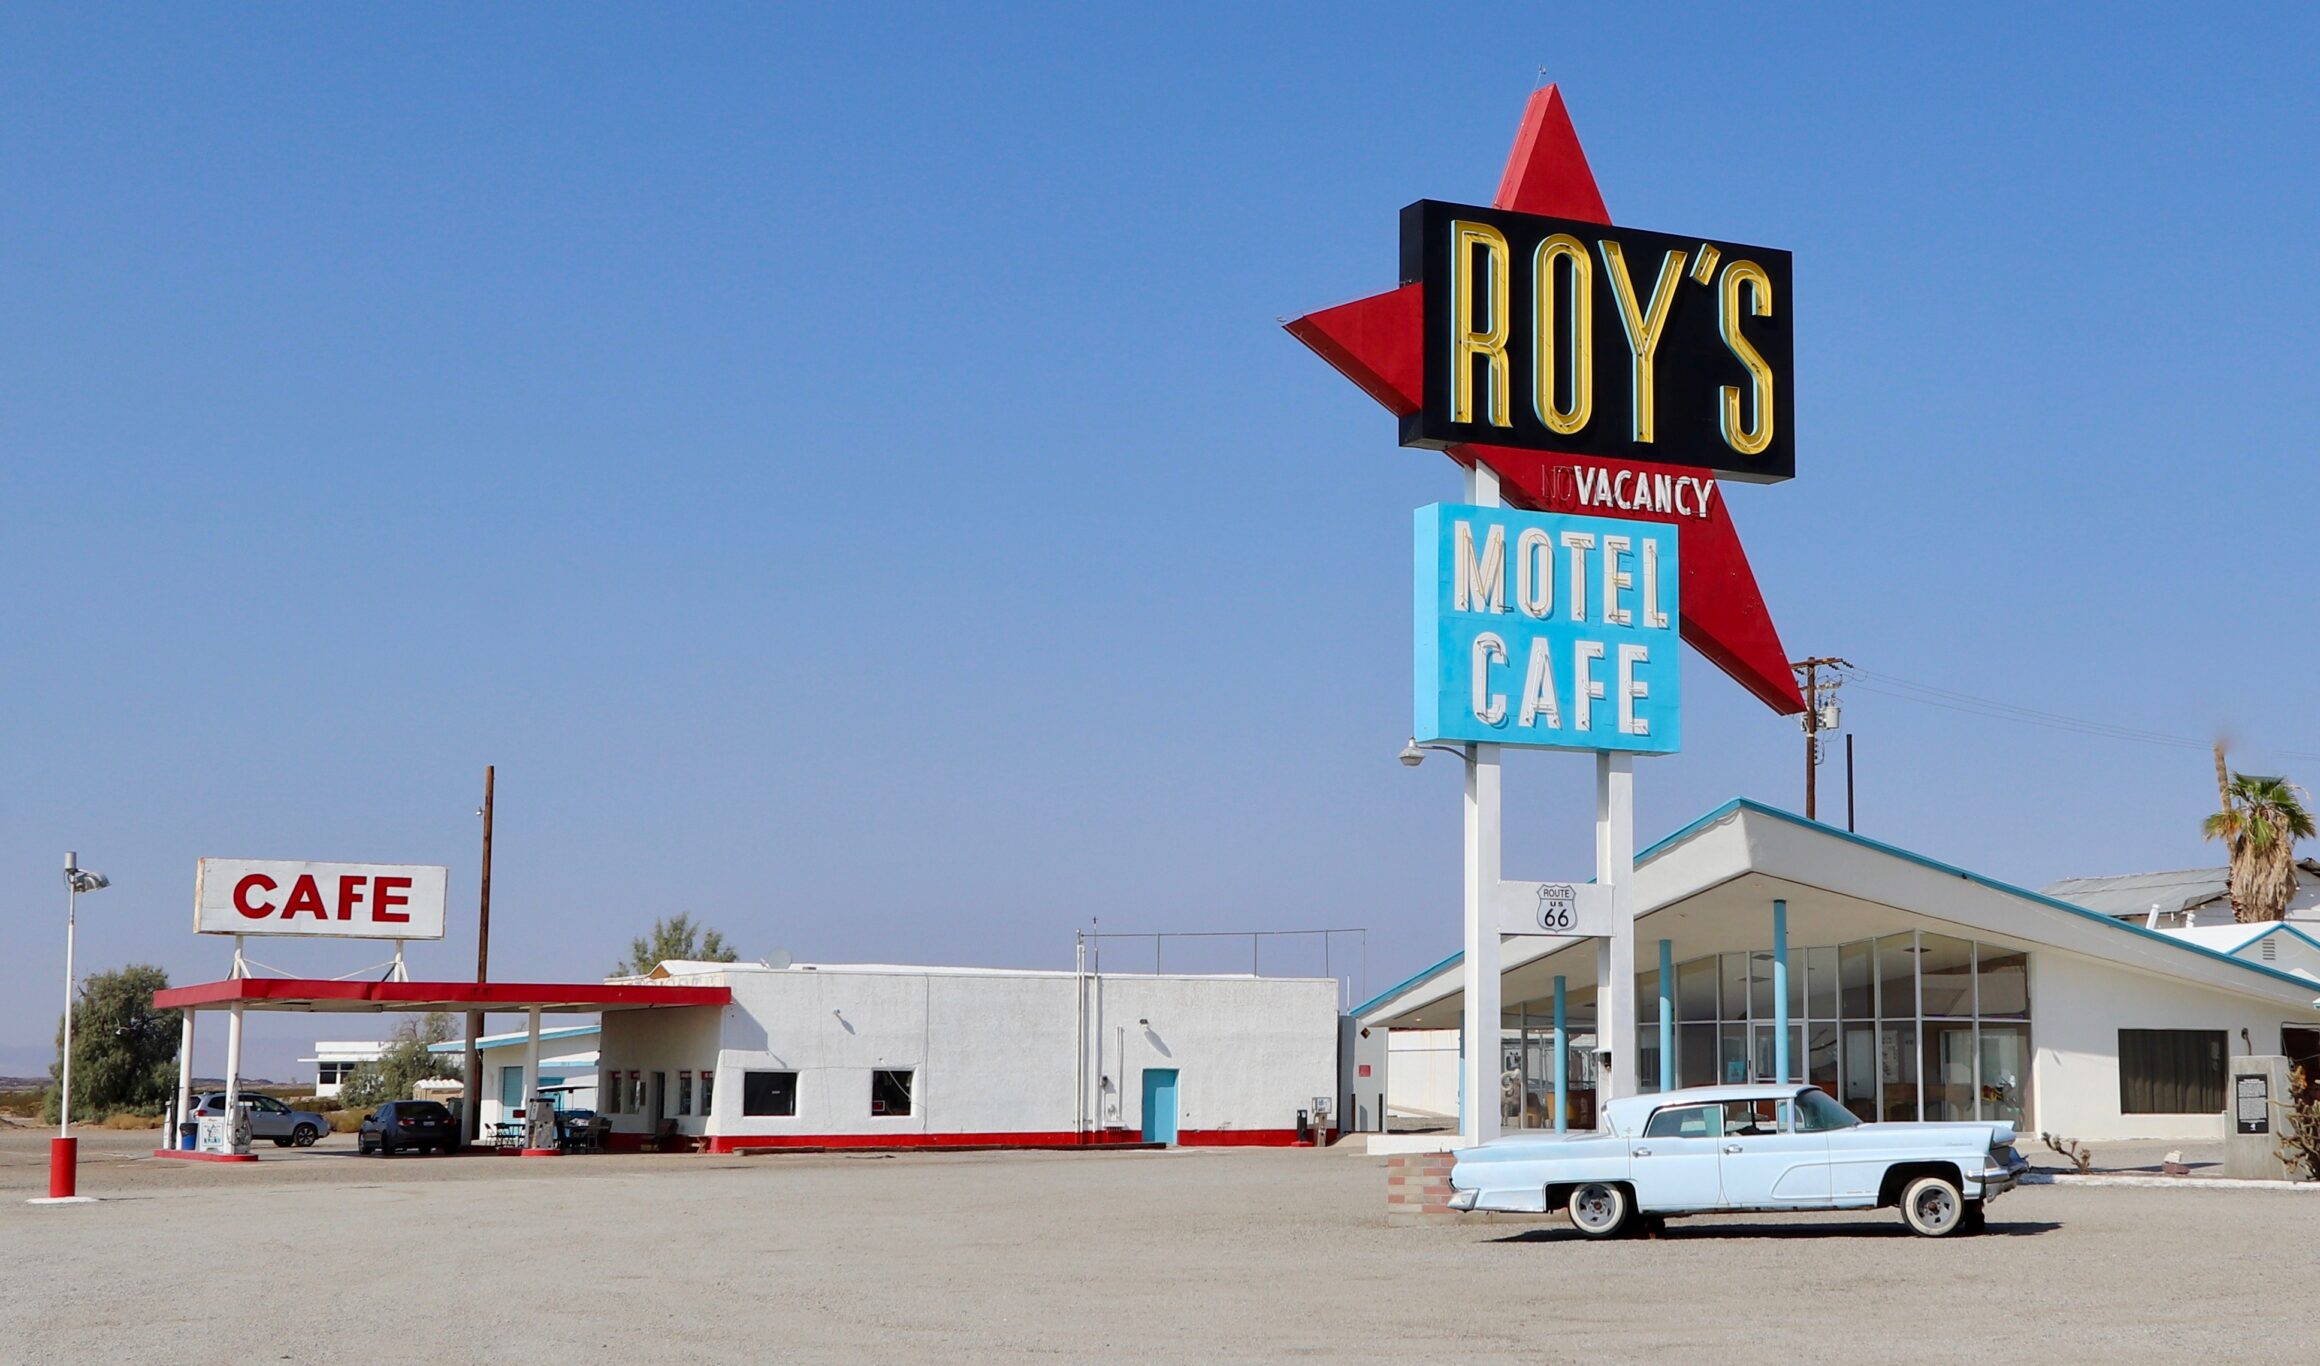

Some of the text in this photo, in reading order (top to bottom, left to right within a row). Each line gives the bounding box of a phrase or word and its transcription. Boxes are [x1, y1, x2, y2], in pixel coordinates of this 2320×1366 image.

[1450, 219, 1774, 455] ROY'S
[1573, 465, 1715, 518] VACANCY
[1453, 520, 1669, 630] MOTEL
[1471, 632, 1650, 736] CAFE
[233, 873, 413, 923] CAFE
[1543, 889, 1570, 898] ROUTE
[1544, 908, 1569, 927] 66
